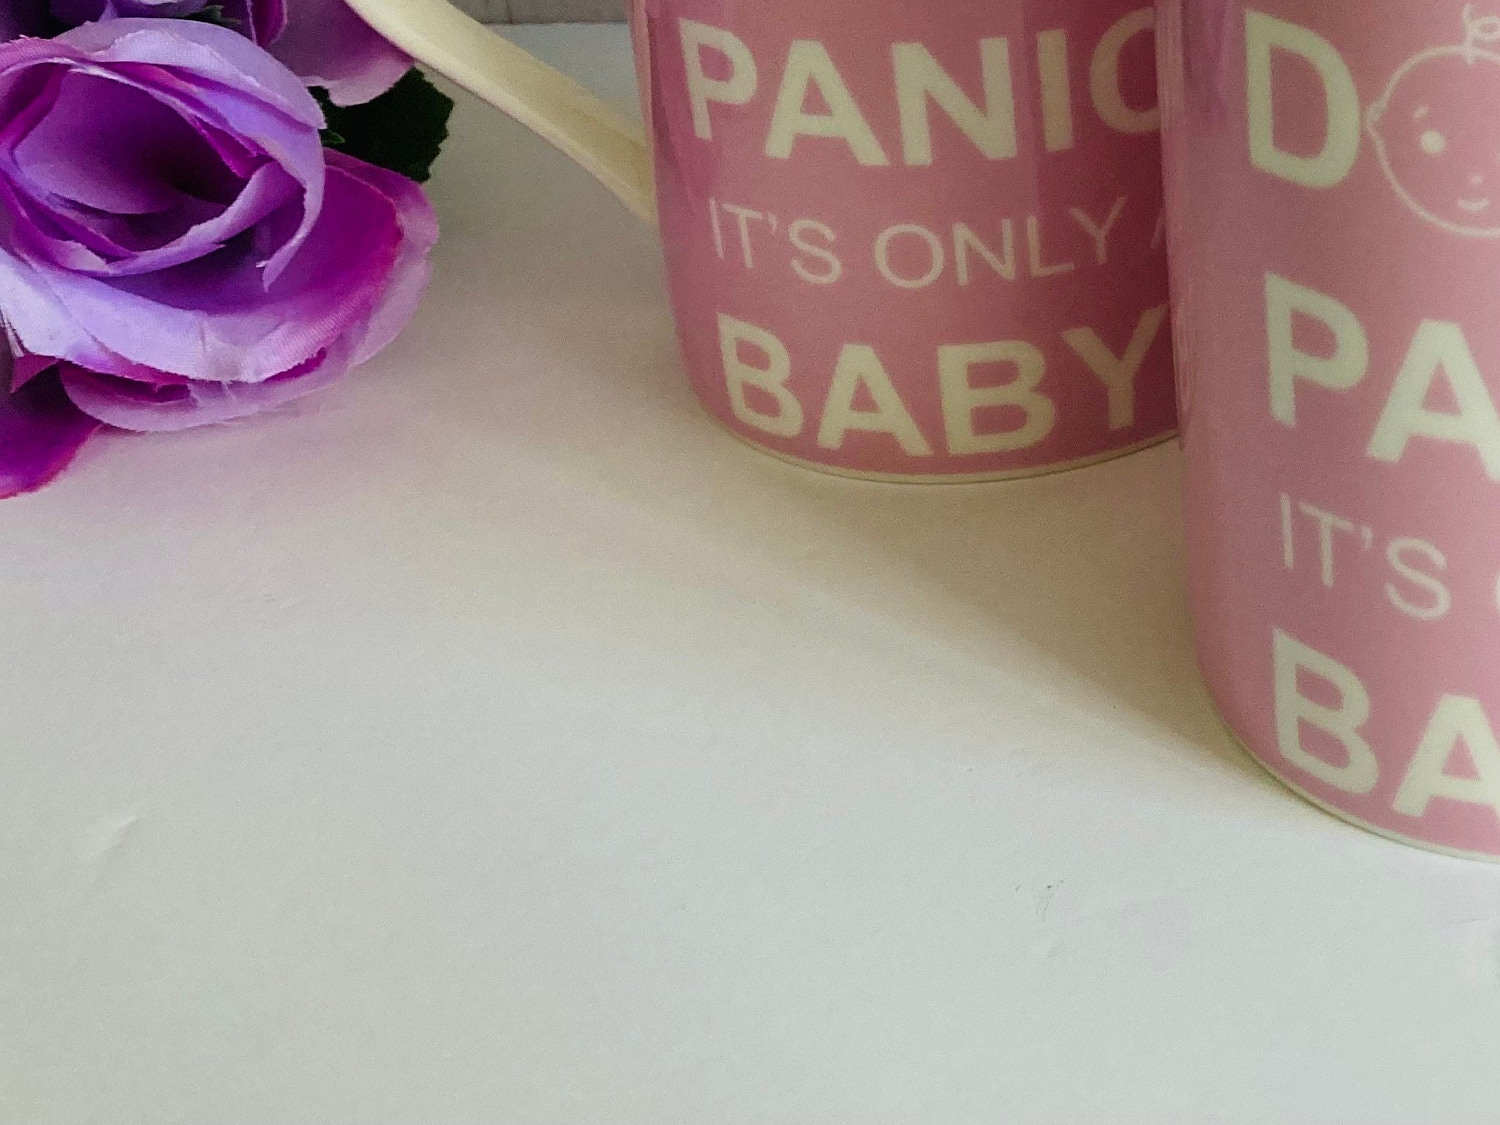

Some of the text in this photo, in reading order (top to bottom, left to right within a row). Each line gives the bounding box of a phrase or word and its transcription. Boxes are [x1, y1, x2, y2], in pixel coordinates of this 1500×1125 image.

[678, 7, 1161, 166] PANIC
[709, 197, 842, 285] IT'S
[874, 196, 1128, 288] ONLY
[1280, 492, 1452, 620] IT'S
